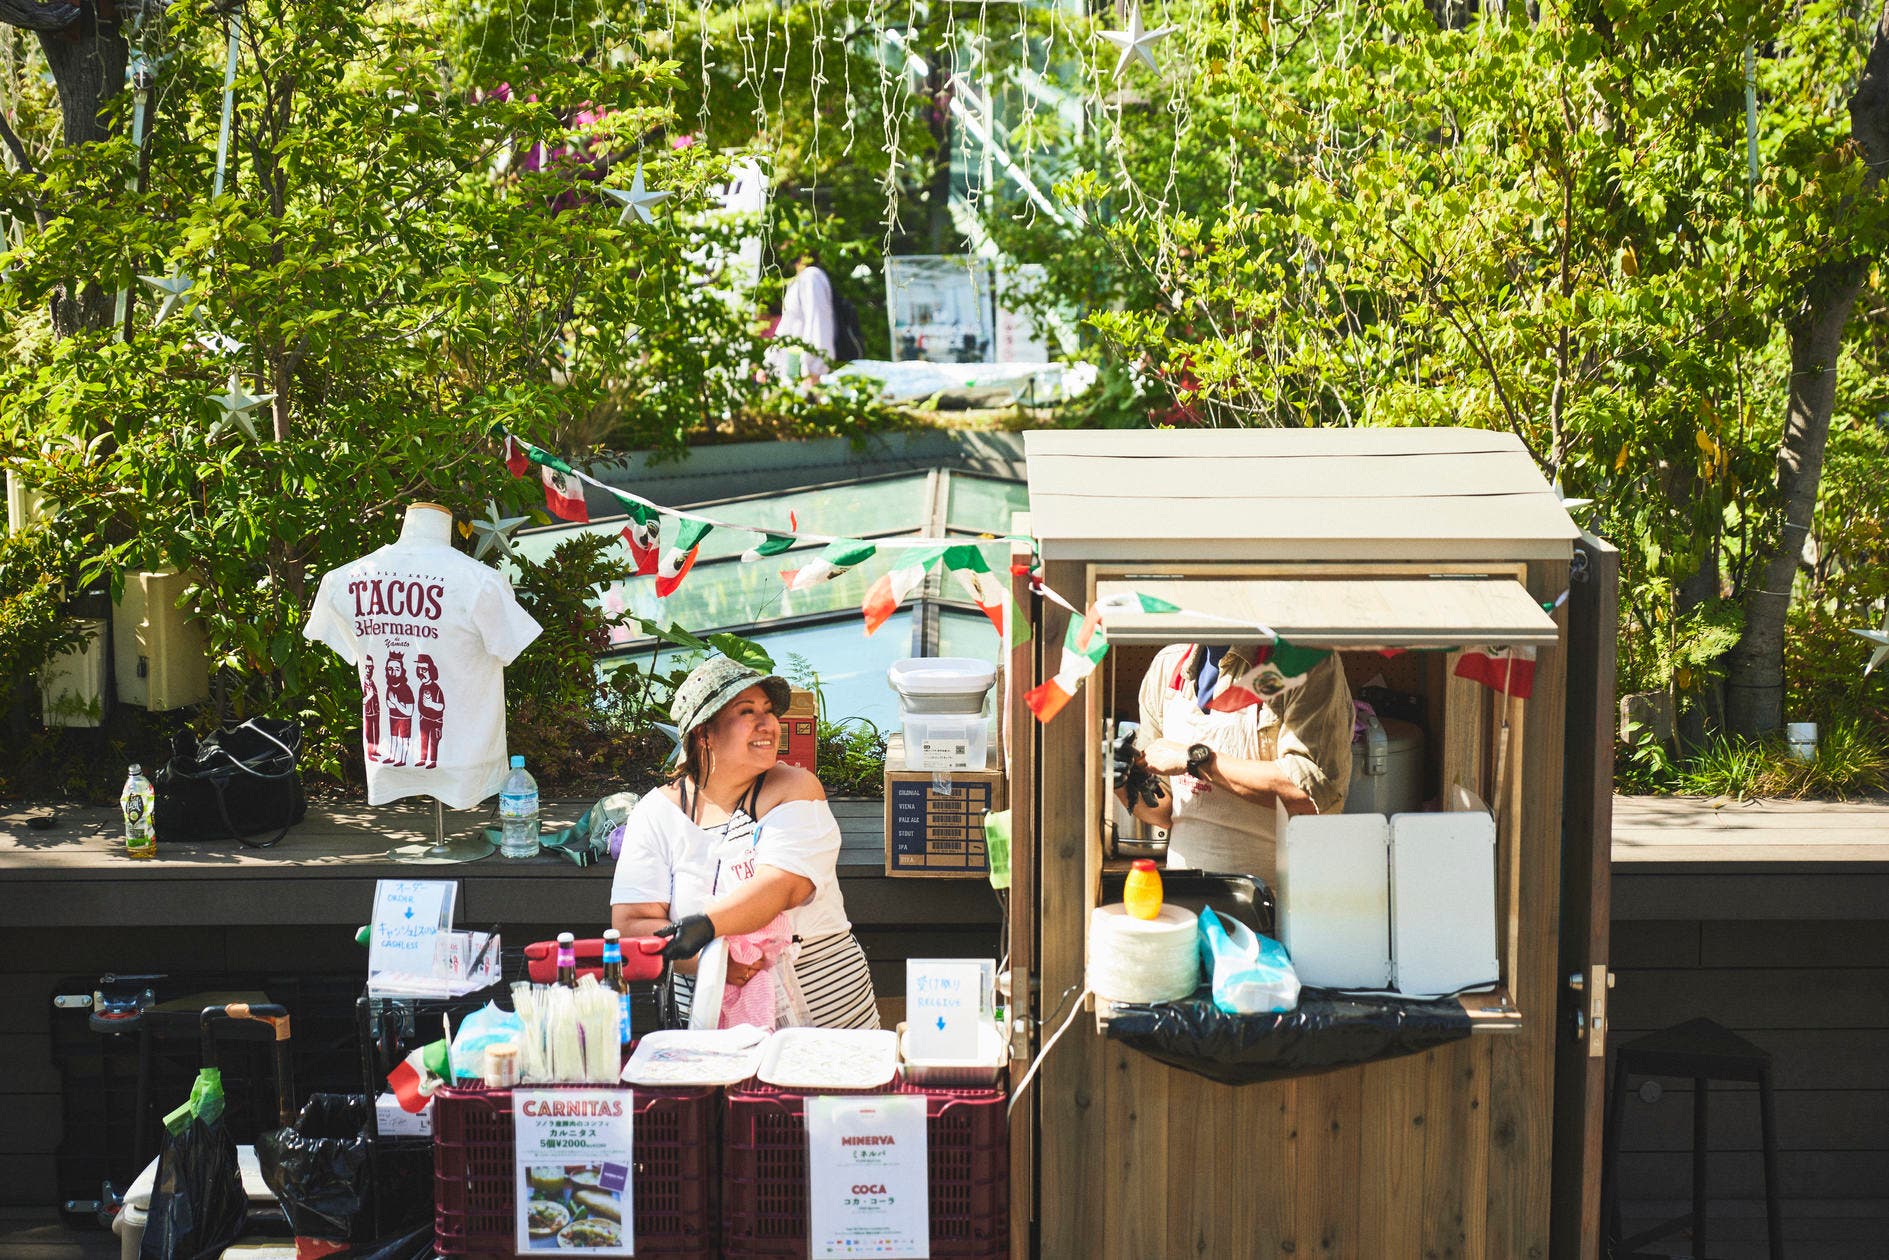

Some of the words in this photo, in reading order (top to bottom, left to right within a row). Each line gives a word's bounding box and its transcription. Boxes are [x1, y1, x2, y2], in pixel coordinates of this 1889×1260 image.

[349, 579, 444, 620] TACOS
[355, 619, 438, 639] 3Hermanos
[522, 1100, 624, 1117] CARNITAS
[549, 1129, 597, 1138] カルニタス
[841, 1135, 896, 1147] MINERVA
[851, 1184, 887, 1195] COCA
[844, 1197, 895, 1206] コカ・コーラ
